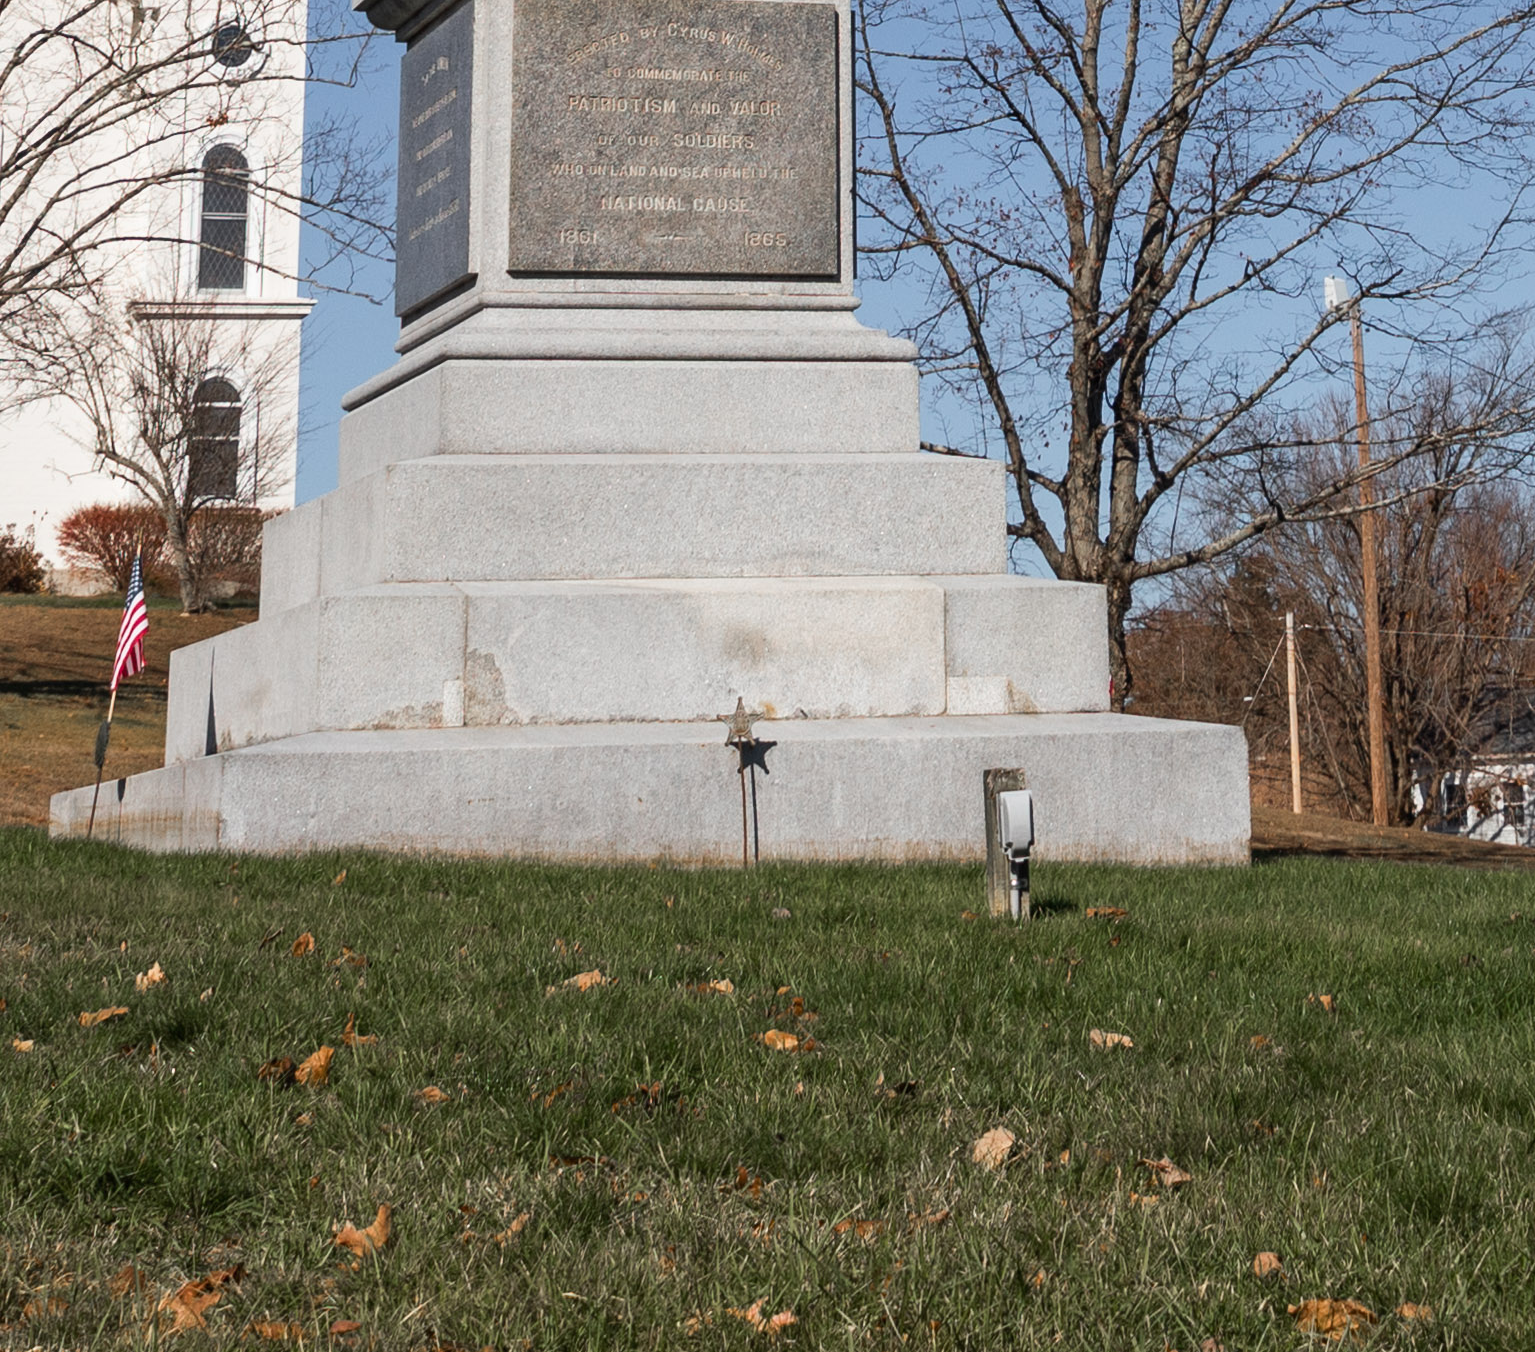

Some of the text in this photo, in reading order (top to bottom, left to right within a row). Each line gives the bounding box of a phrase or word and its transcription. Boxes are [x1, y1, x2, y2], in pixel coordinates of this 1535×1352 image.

[567, 31, 629, 65] ERECTED
[640, 25, 660, 39] BY
[627, 67, 722, 82] COMMEMORATE
[727, 70, 751, 83] THE
[568, 96, 782, 116] PATRIOTISM AND VALOR
[598, 132, 754, 149] OF OUR SOLDIERS
[551, 163, 799, 180] WHO ON LAND AND SEA UPHELD THE
[600, 195, 686, 212] NATIONAL
